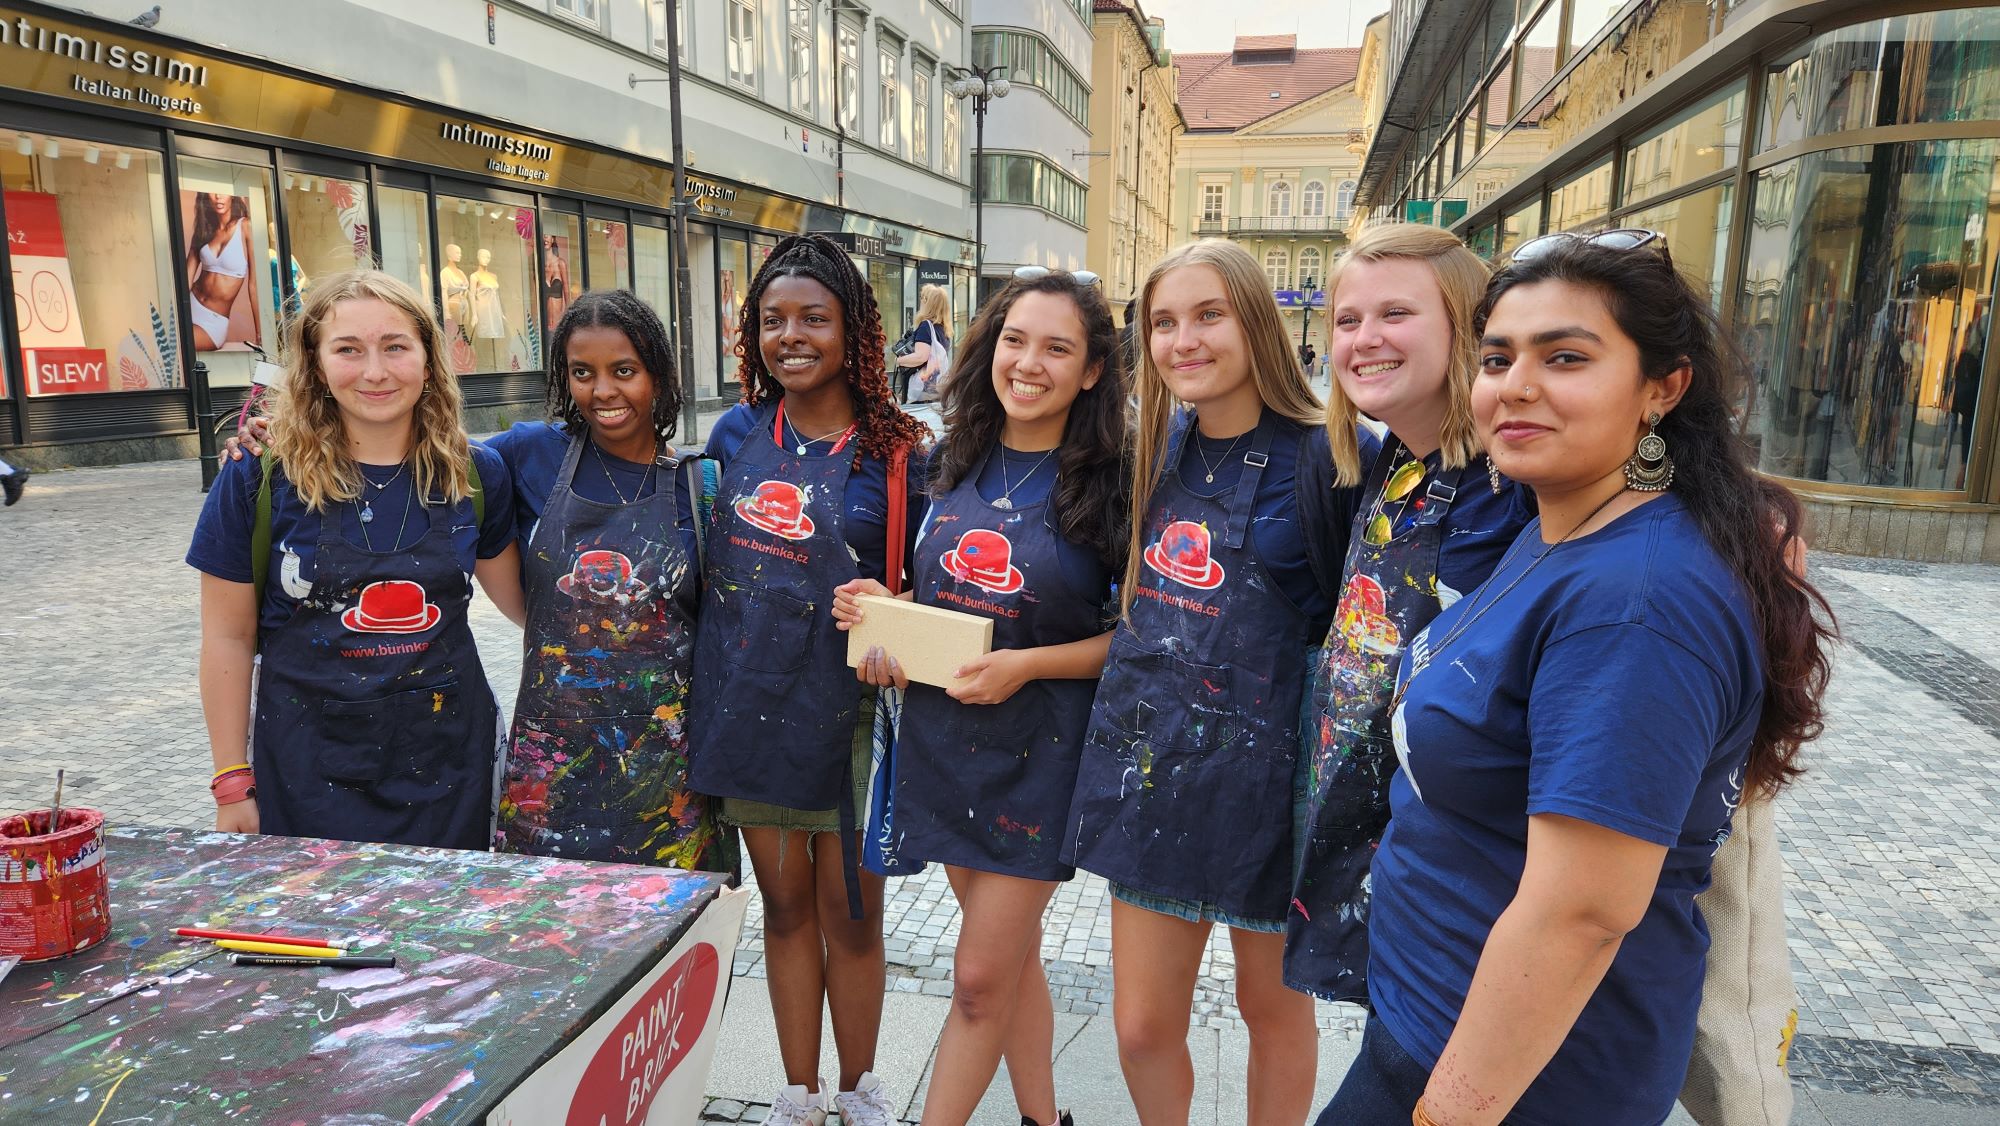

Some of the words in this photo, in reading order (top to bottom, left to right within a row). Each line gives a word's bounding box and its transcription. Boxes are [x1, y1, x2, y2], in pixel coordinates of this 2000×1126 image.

[74, 74, 132, 101] Italian
[138, 87, 202, 114] lingerie
[443, 122, 553, 161] intimissimi
[488, 158, 516, 175] Italian
[518, 165, 549, 180] lingerie
[686, 176, 738, 202] timissimi
[855, 236, 885, 257] HOTEL
[41, 362, 103, 385] SLEVY
[936, 591, 1021, 618] www.burinka.cz
[620, 974, 683, 1081] PAINT
[625, 1012, 684, 1124] BRICK
